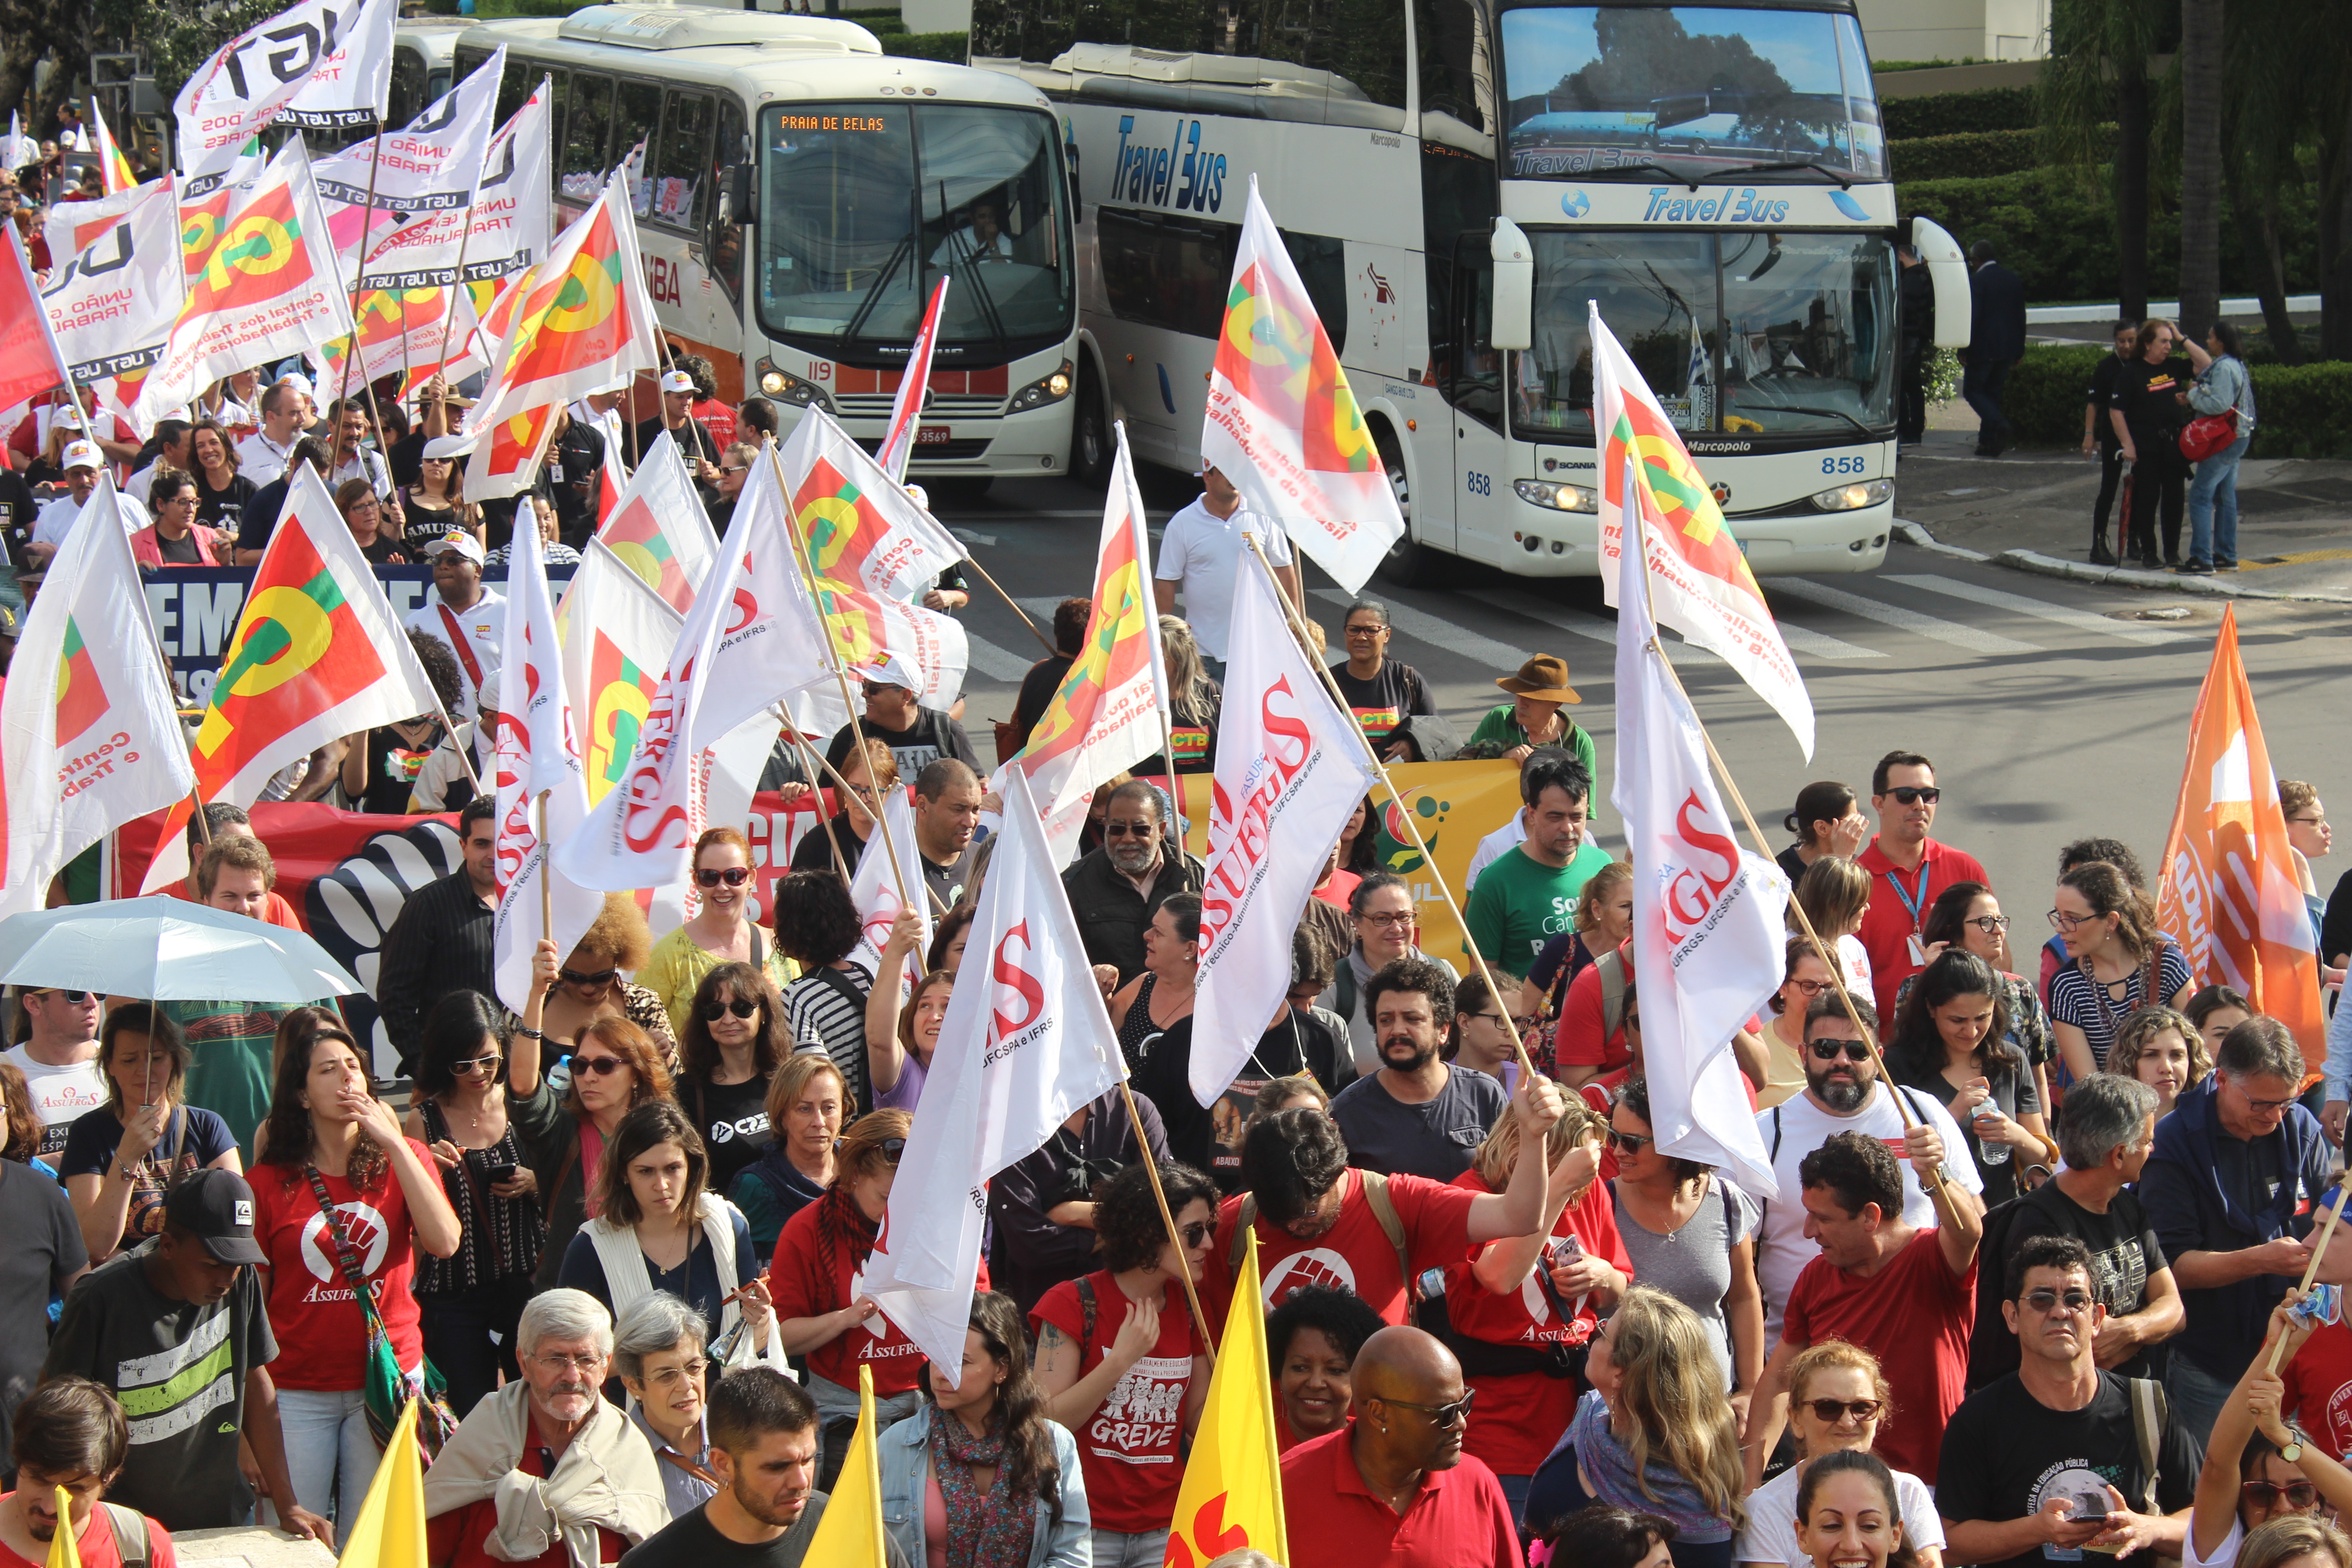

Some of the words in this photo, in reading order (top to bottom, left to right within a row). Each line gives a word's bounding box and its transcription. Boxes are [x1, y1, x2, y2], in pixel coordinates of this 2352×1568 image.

[781, 116, 818, 129] PRAIA
[823, 117, 838, 129] DE
[843, 118, 883, 131] BELAS
[1370, 132, 1401, 149] Marcopolo
[1112, 115, 1183, 208] Travel
[1177, 120, 1226, 214] Bus
[1514, 148, 1596, 175] Travel
[1644, 188, 1733, 221] Travel
[1732, 189, 1788, 222] Bus
[808, 361, 831, 381] 119
[1687, 441, 1751, 453] Marcopolo
[1559, 461, 1596, 470] SCANIA
[1822, 456, 1864, 475] 858
[1467, 470, 1491, 497] 858
[743, 624, 765, 640] IFRS
[1361, 713, 1397, 726] CTB
[1172, 733, 1209, 746] CTB
[1274, 776, 1304, 813] UFCSPA
[1307, 749, 1322, 774] IFRS
[1705, 894, 1736, 931] UFCSPA
[1021, 1036, 1027, 1045] e
[1029, 1017, 1053, 1041] IFRS
[1215, 1156, 1240, 1166] ABAIXO
[1144, 1359, 1168, 1367] REALMENTE
[1091, 1418, 1176, 1450] GREVE
[2065, 1458, 2088, 1468] PÚBLICA
[2037, 1462, 2064, 1485] EDUCAÇÃO
[2031, 1483, 2041, 1493] DA
[2028, 1494, 2037, 1515] DEFESA
